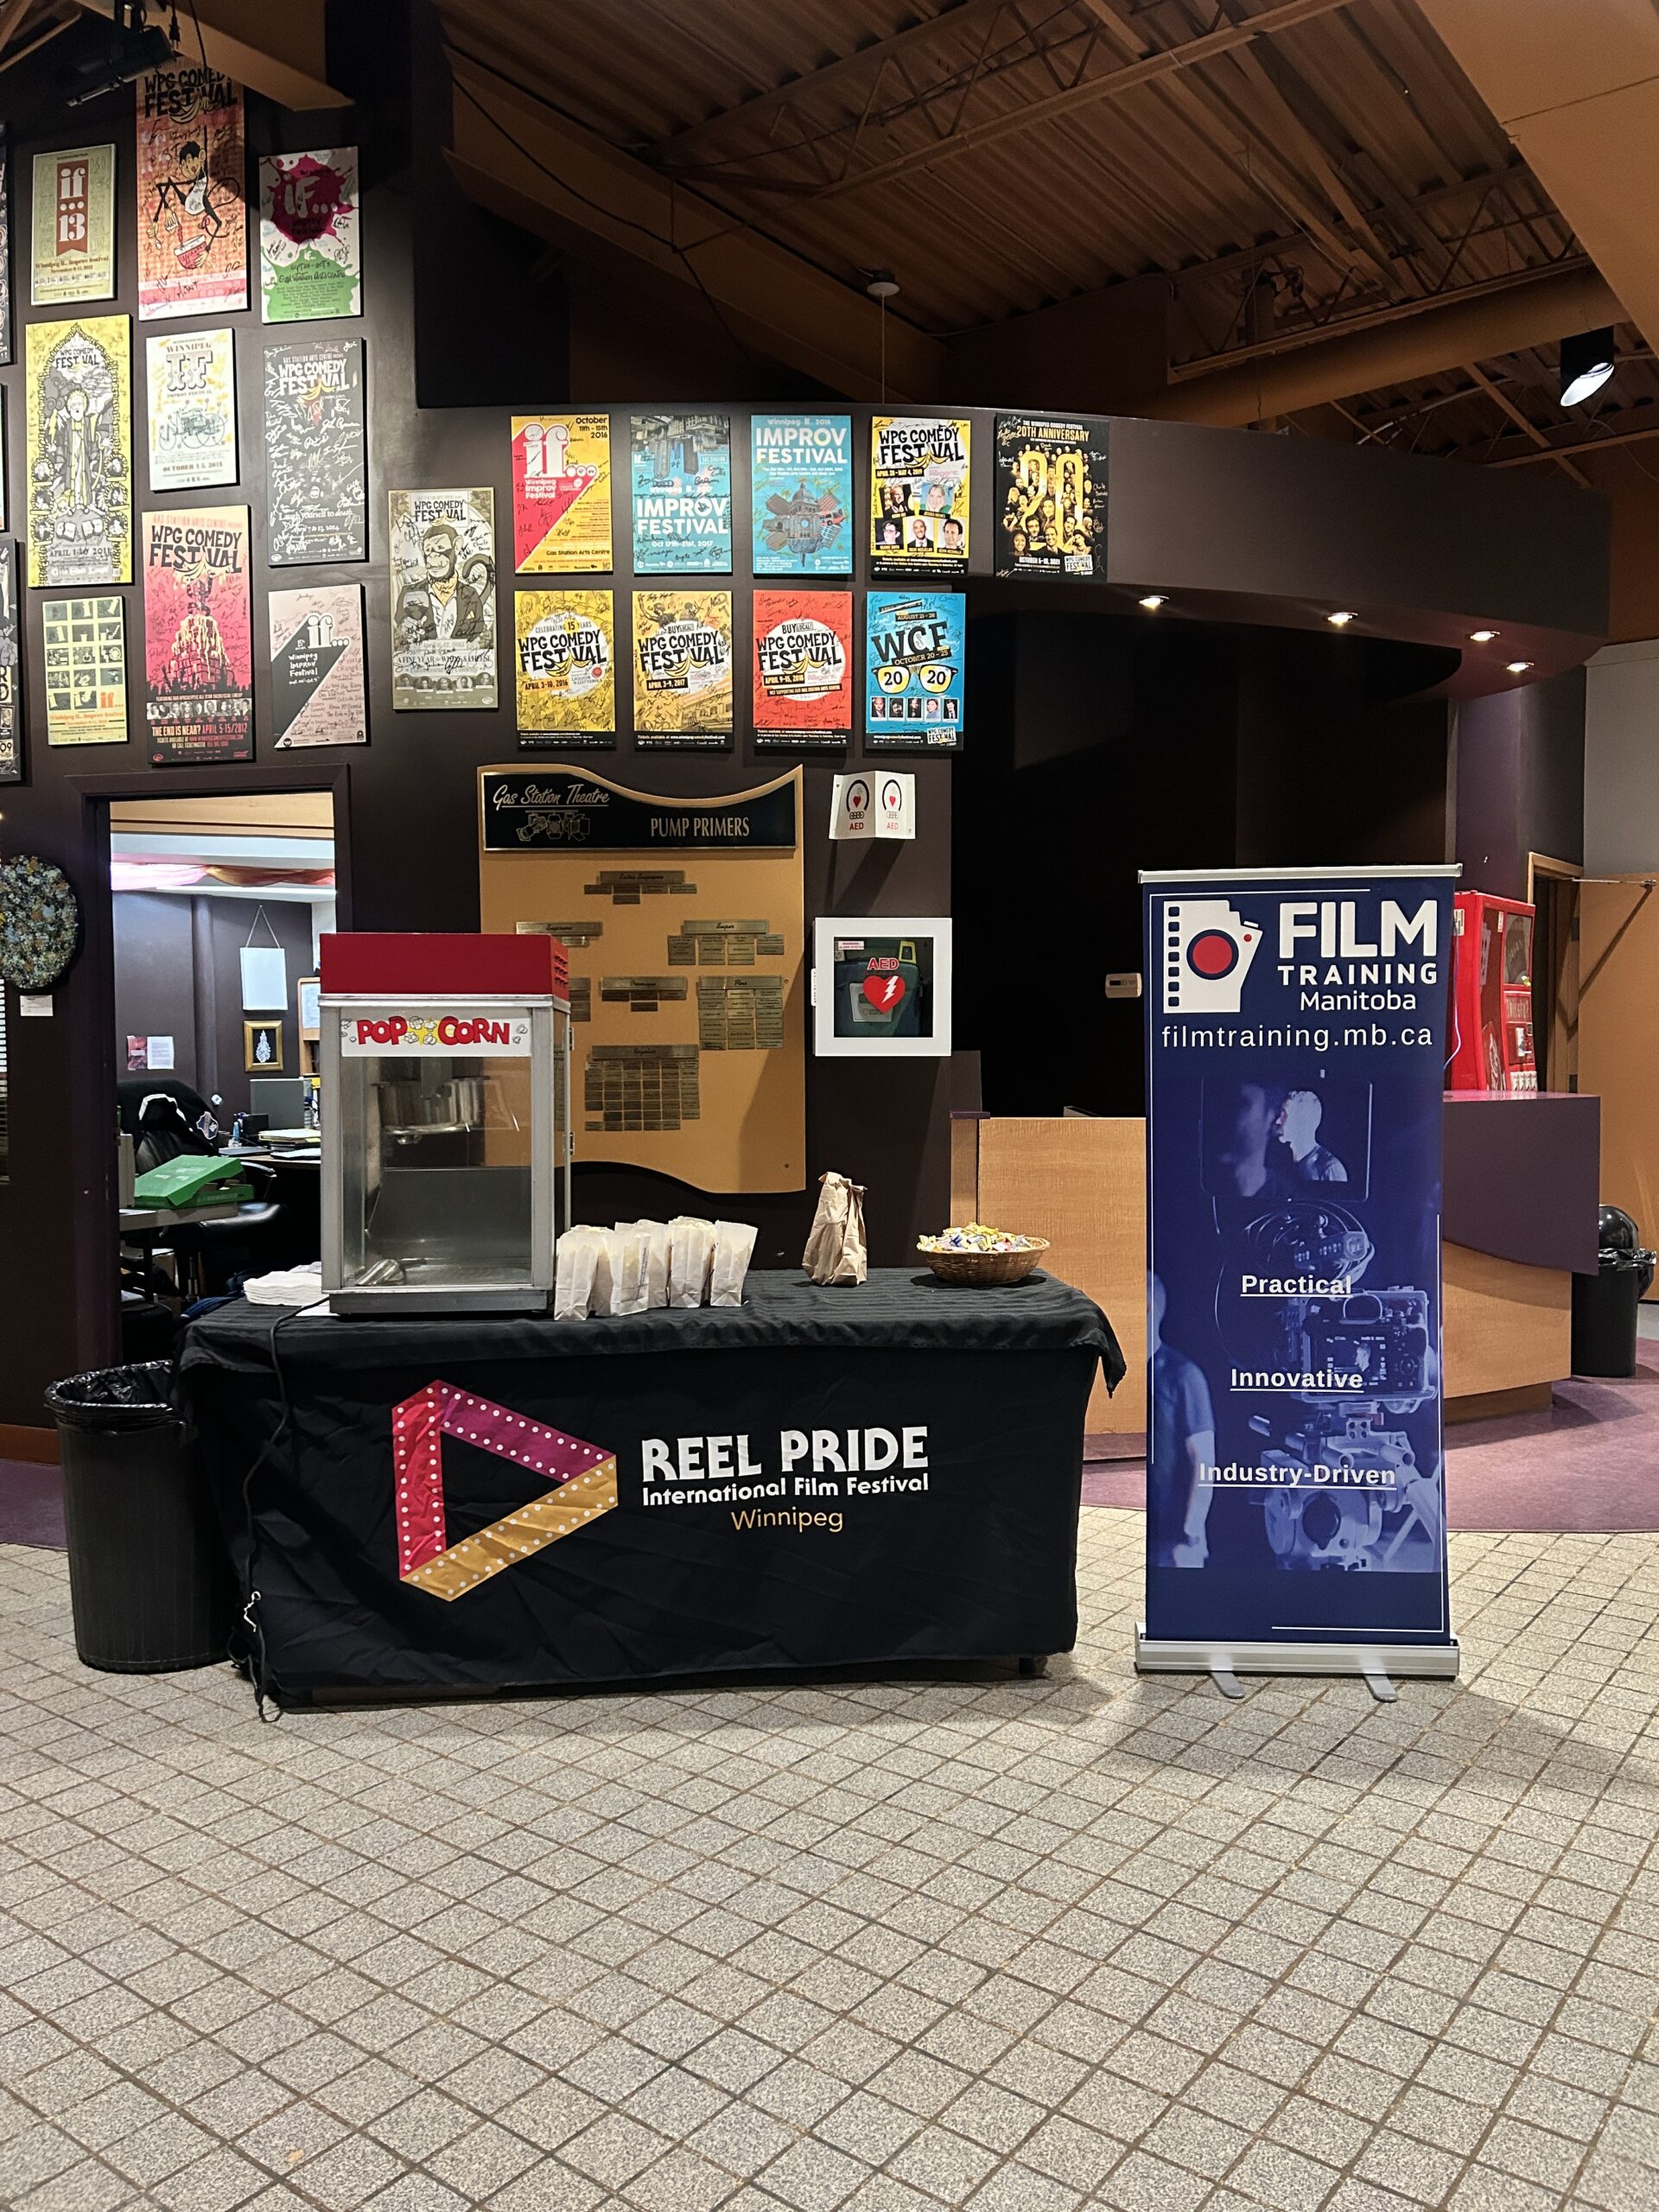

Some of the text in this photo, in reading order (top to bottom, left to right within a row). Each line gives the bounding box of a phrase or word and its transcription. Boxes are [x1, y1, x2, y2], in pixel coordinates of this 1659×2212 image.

[59, 213, 86, 242] 13
[167, 342, 212, 353] WINNIPEG
[278, 359, 347, 378] WPG COMEDY
[766, 418, 801, 427] Winnipeg
[755, 428, 847, 447] IMPROV
[878, 427, 960, 444] WPG COMEDY
[1016, 425, 1037, 437] 20TH
[1038, 428, 1090, 442] ANNIVERSARY
[756, 448, 849, 464] FESTIVAL
[414, 499, 463, 510] WPG COMEDY
[524, 491, 556, 499] Festival
[636, 498, 728, 518] IMPROV
[637, 518, 729, 535] FESTIVAL
[151, 525, 243, 550] WPG COMEDY
[535, 624, 566, 633] CELEBRATING
[567, 621, 575, 631] 15
[667, 625, 680, 634] BUY
[781, 623, 796, 634] BUY
[517, 629, 601, 652] WPG COMEDY
[638, 631, 719, 652] WPG COMEDY
[755, 631, 836, 652] WPG COMEDY
[871, 621, 948, 663] WCF
[289, 652, 318, 662] Winnipeg
[894, 654, 925, 665] OCTOBER
[289, 667, 318, 677] Festival
[765, 676, 779, 684] APRIL
[884, 670, 946, 685] 20 20
[152, 726, 162, 736] THE
[163, 725, 175, 736] END
[175, 725, 181, 735] IS
[181, 724, 201, 735] NEAR?
[202, 723, 218, 734] APRIL
[493, 783, 610, 810] Gas Station Theatre
[651, 817, 750, 837] PUMP PRIMERS
[849, 822, 864, 830] AED
[715, 922, 734, 931] Super
[1279, 899, 1438, 959] FILM
[867, 957, 900, 971] AED
[1277, 963, 1438, 986] TRAINING
[1300, 989, 1417, 1012] Manitoba
[356, 1015, 511, 1046] POP CORN
[1161, 1023, 1433, 1052] filmtraining.mb.ca
[1241, 1274, 1352, 1294] Practical
[1230, 1368, 1364, 1389] Innovative
[641, 1426, 929, 1482] REEL PRIDE
[1199, 1462, 1396, 1487] Industry-Driven
[642, 1472, 929, 1506] International Film Festival
[731, 1506, 844, 1533] Winnipeg
